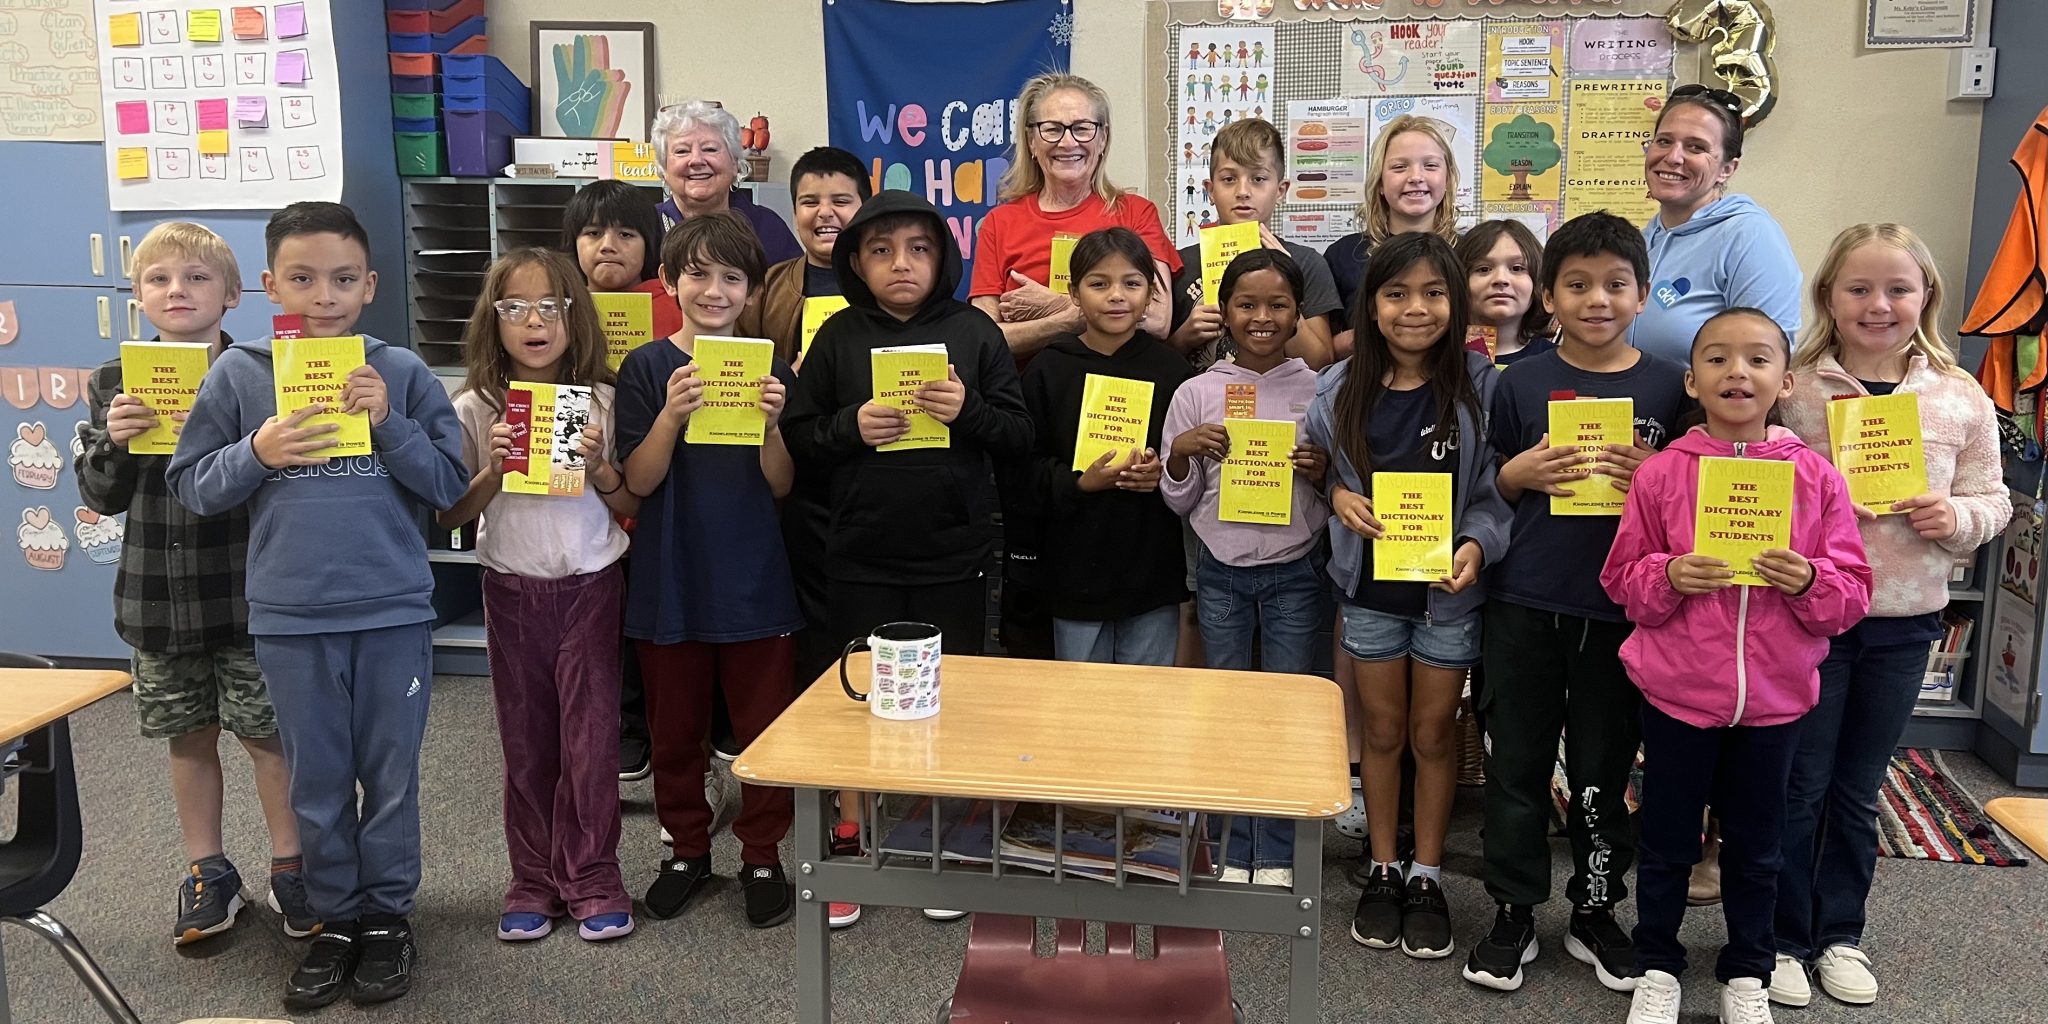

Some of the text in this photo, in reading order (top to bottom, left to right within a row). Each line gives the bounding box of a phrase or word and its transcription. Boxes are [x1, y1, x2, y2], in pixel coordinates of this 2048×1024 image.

[1390, 23, 1448, 39] HOOK your
[1584, 40, 1657, 49] WRITING
[162, 58, 172, 66] 12
[202, 57, 212, 66] 13
[244, 56, 254, 64] 14
[1521, 59, 1549, 67] SENTENCE
[1434, 71, 1477, 79] question
[1433, 81, 1465, 90] quote
[1575, 83, 1663, 91] PREWRITING
[164, 104, 175, 112] 17
[1380, 98, 1412, 117] OREO
[1582, 131, 1651, 139] DRAFTING
[634, 144, 650, 159] #1
[1511, 159, 1533, 167] REASON
[619, 162, 658, 177] Teach
[925, 156, 1010, 206] Har
[1220, 249, 1240, 257] BEST
[1657, 287, 1677, 308] ckh
[305, 360, 331, 369] THE
[152, 366, 177, 374] THE
[304, 372, 334, 380] BEST
[282, 382, 348, 393] DICTIONA
[898, 379, 924, 387] BEST
[880, 389, 915, 398] DICTIO
[309, 395, 334, 404] FOR
[702, 400, 756, 408] STUDENTS
[1108, 395, 1127, 404] THE
[1104, 404, 1128, 413] BEST
[534, 415, 554, 423] BES
[1086, 412, 1143, 425] DICTIONARY
[1861, 417, 1886, 427] THE
[1103, 424, 1123, 433] FOR
[1578, 422, 1602, 430] THE
[1088, 432, 1136, 444] STUDENTS
[1860, 429, 1890, 438] BEST
[1839, 438, 1914, 453] DICTIONARY
[1245, 449, 1270, 457] BEST
[1865, 452, 1890, 461] FOR
[1227, 459, 1287, 468] DICTIONARY
[1848, 462, 1911, 475] STUDENTS
[1231, 479, 1281, 488] STUDENTS
[1731, 483, 1758, 491] THE
[1728, 495, 1759, 503] BEST
[1704, 505, 1783, 517] DICTIONARY
[1380, 513, 1444, 521] DICTIONARY
[1729, 519, 1755, 528] FOR
[1386, 534, 1440, 542] STUDENTS
[1709, 531, 1774, 541] STUDENTS
[28, 552, 60, 564] AUGUST
